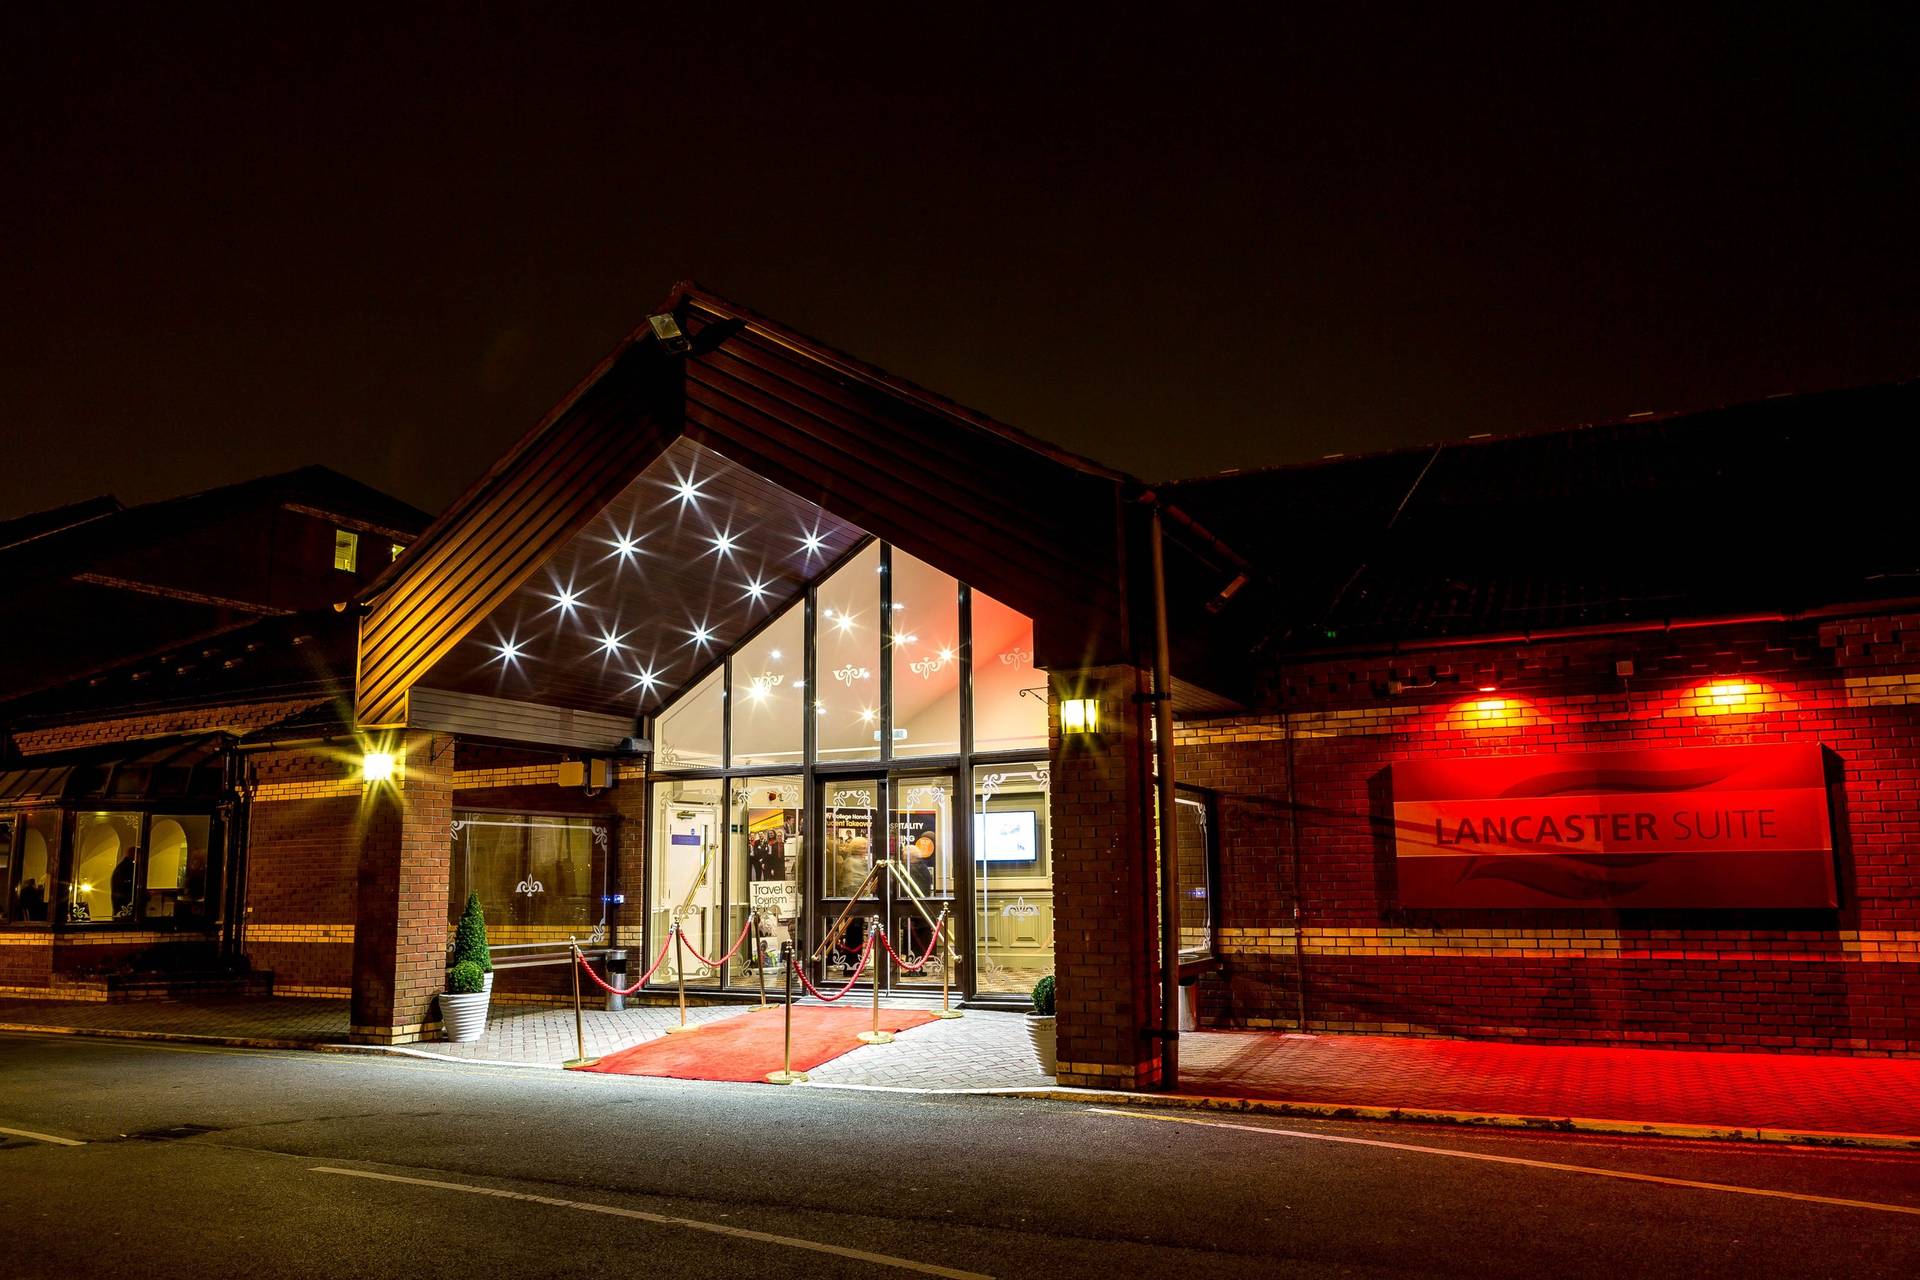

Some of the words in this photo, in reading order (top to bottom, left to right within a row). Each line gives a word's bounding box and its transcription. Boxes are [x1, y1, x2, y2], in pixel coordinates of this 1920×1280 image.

[1435, 811, 1659, 846] LANCASTER
[1672, 807, 1777, 841] SUITE
[753, 883, 783, 895] Travel
[753, 895, 787, 904] Tourism
